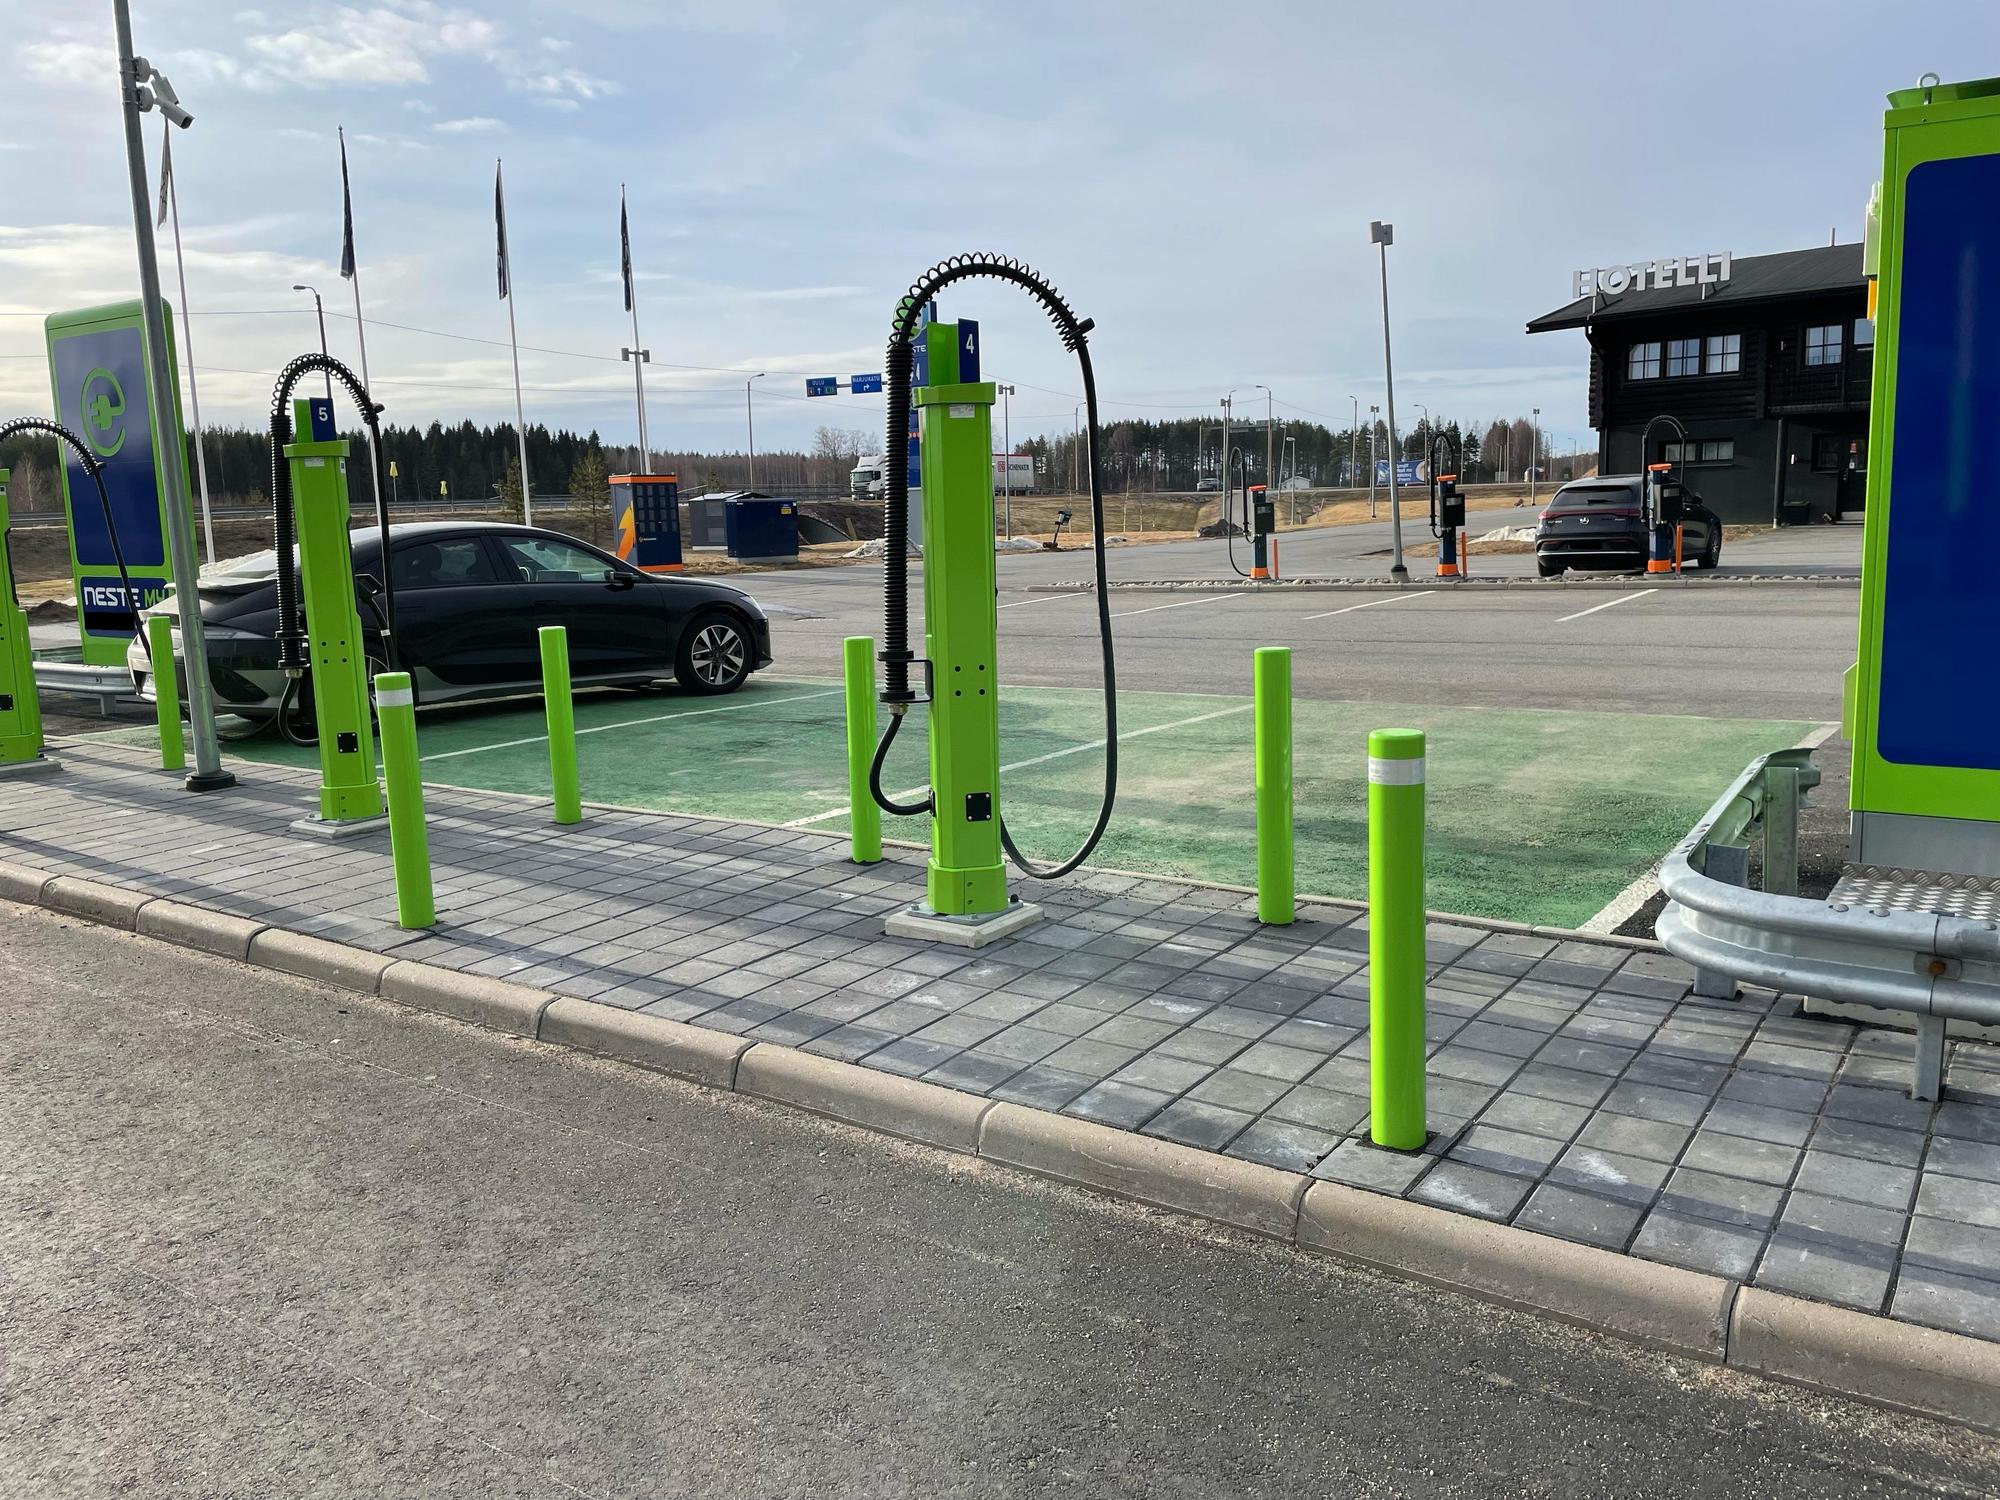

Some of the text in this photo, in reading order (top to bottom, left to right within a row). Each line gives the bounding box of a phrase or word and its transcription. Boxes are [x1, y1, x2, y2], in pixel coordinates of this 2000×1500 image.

[1573, 251, 1731, 298] HOTELLI
[912, 344, 927, 353] STE
[966, 333, 974, 354] 4
[318, 407, 328, 421] 5
[83, 586, 141, 607] NESTE
